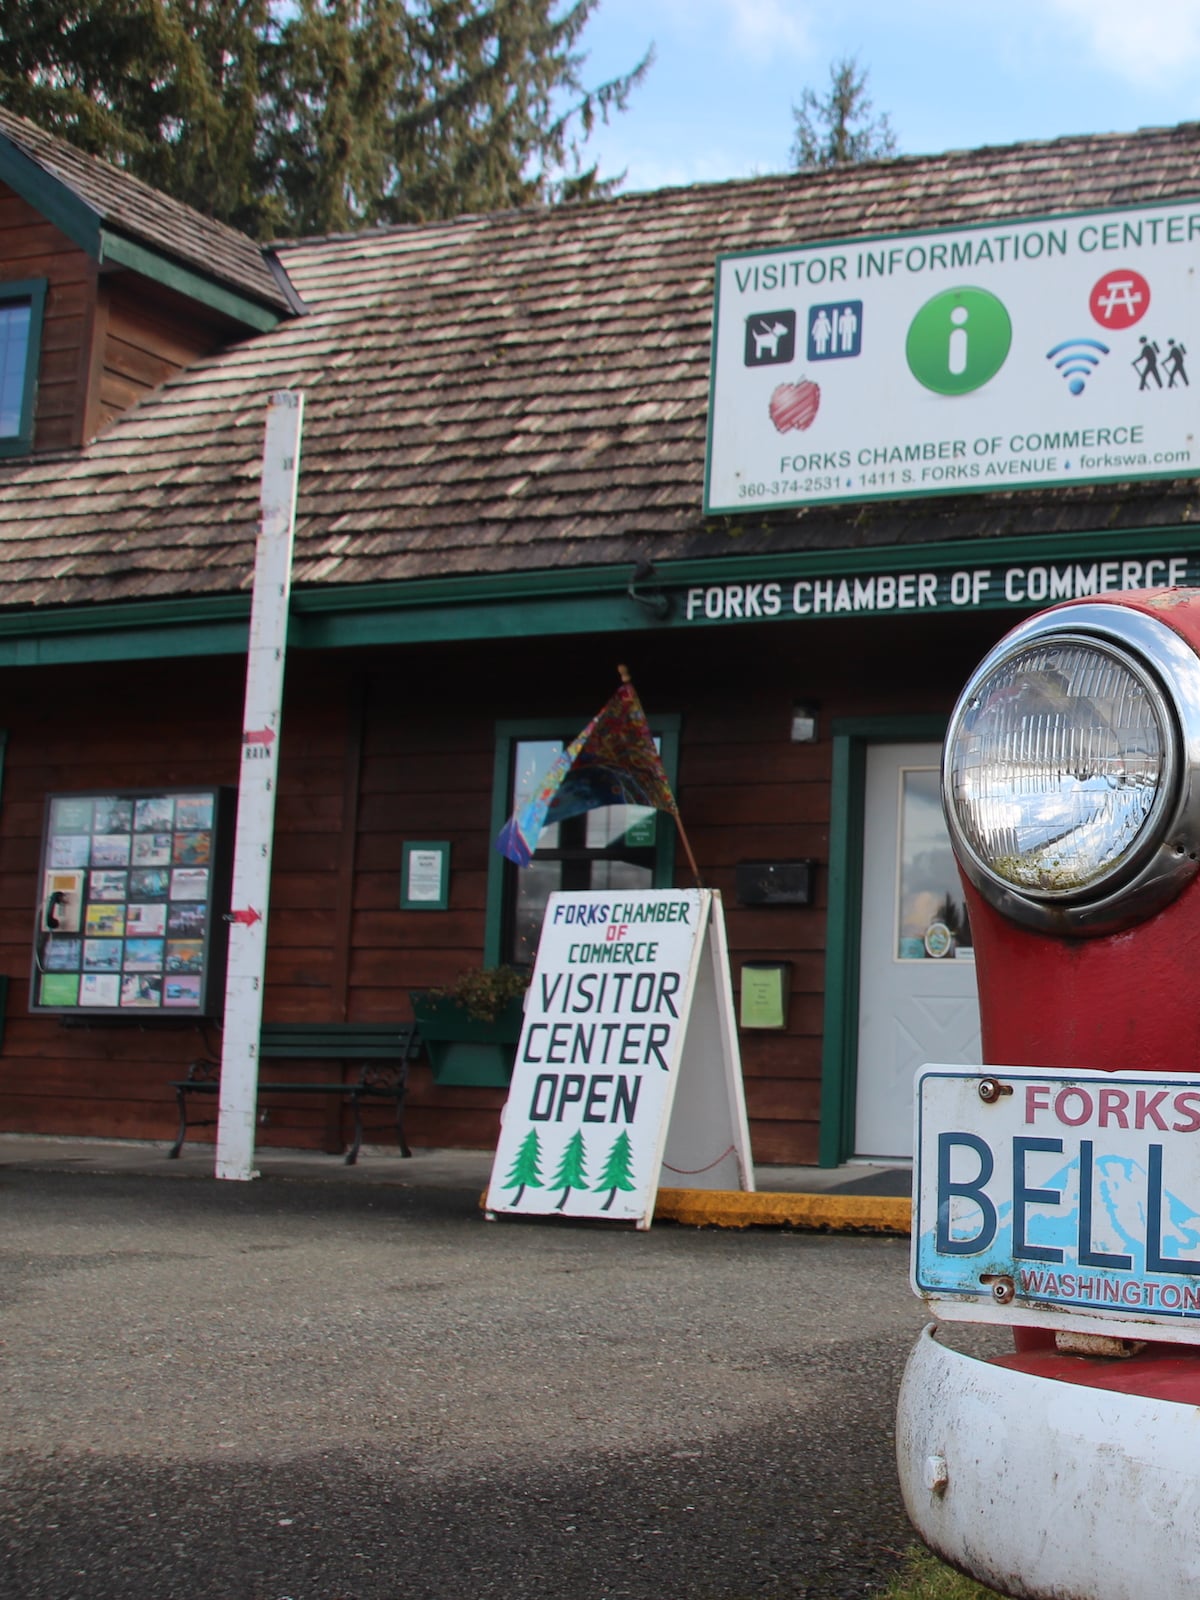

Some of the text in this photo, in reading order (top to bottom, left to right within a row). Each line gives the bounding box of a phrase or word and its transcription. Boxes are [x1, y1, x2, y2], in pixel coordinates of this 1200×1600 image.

[734, 257, 847, 294] VISITOR
[857, 229, 1069, 278] INFORMATION
[780, 425, 1144, 473] FORKS CHAMBER OF COMMERCE
[738, 449, 1191, 498] 360-374-2531 1411 S. FORKS AVENUE forkswa.com
[686, 558, 1188, 620] FORKS CHAMBER OF COMMERCE
[553, 902, 690, 925] FORKS CHAMBER
[606, 925, 628, 941] OF
[568, 942, 659, 964] COMMERCE
[541, 972, 680, 1019] VISITOR
[522, 1023, 671, 1072] CENTER
[528, 1073, 643, 1124] OPEN
